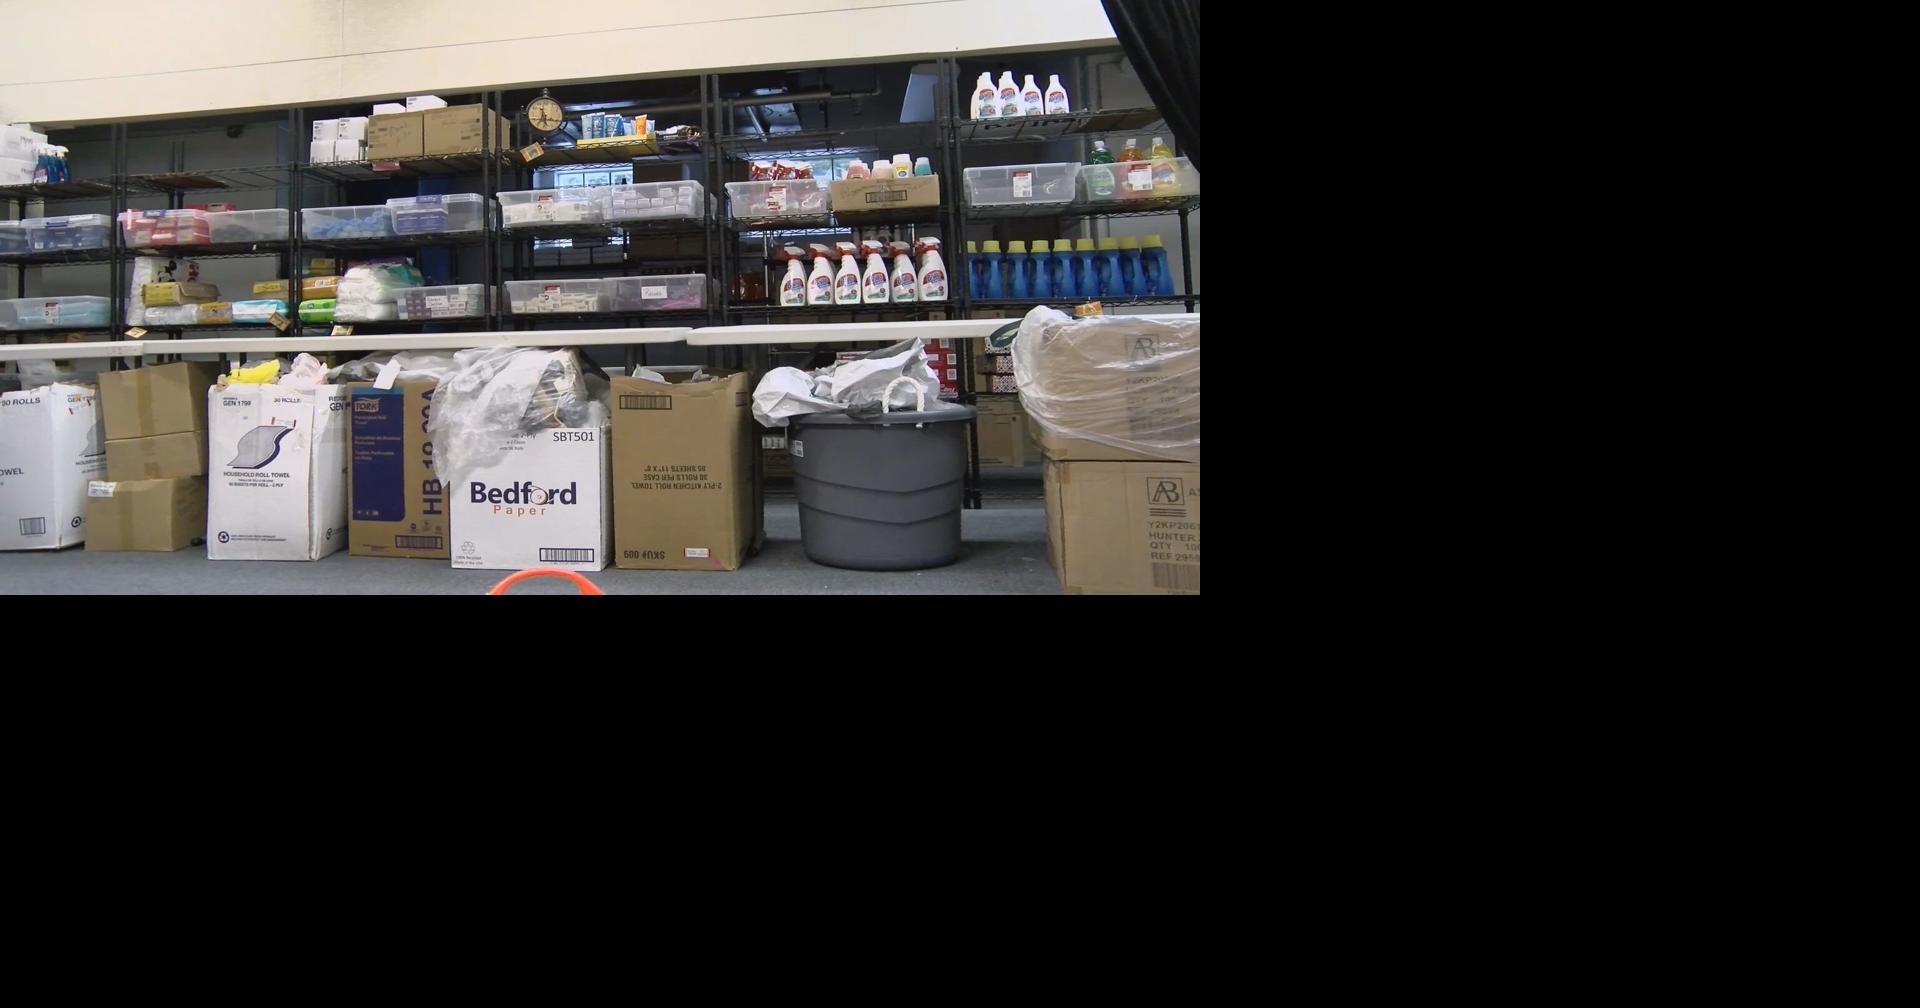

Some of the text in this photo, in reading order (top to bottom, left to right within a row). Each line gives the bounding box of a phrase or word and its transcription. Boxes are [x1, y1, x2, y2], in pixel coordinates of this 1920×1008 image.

[12, 397, 41, 406] ROLLS
[355, 402, 378, 411] TORK
[553, 431, 595, 442] SBT501
[643, 473, 660, 481] CASE
[661, 473, 675, 481] PER
[676, 473, 698, 481] ROLLS
[631, 482, 723, 490] 2-PLY KITCHEN ROLL TOWEL
[470, 481, 577, 506] Bedford
[1151, 480, 1181, 503] AB
[422, 478, 442, 515] HB
[493, 505, 547, 517] Paper
[1148, 531, 1196, 542] HUNTER
[1150, 541, 1172, 550] QTY
[623, 550, 666, 560] SKU# 009
[1151, 551, 1173, 560] REF
